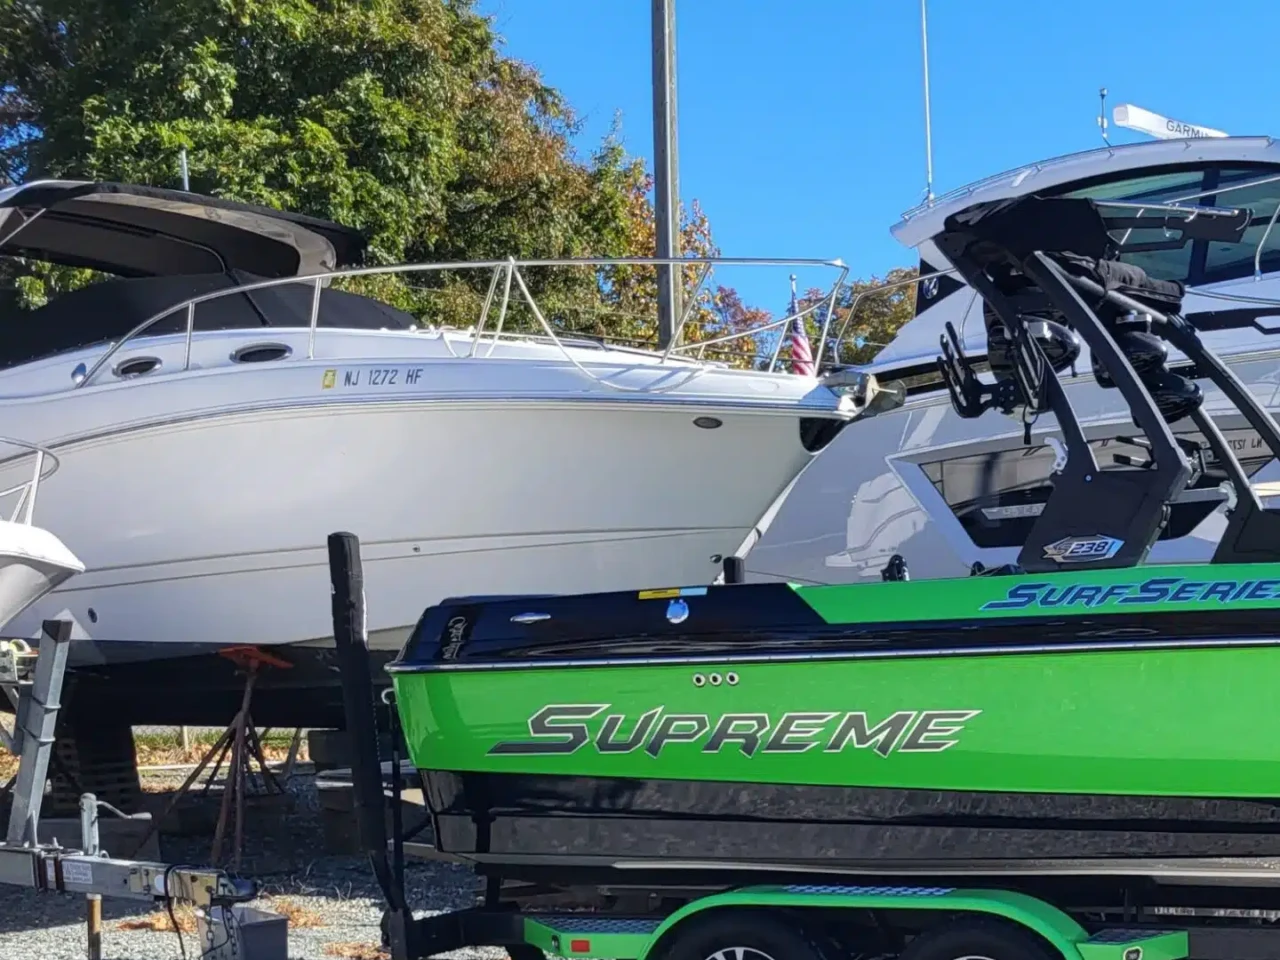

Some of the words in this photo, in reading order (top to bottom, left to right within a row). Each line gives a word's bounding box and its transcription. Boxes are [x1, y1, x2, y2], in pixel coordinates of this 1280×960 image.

[343, 370, 360, 387] NJ
[368, 369, 398, 386] 1272
[405, 368, 423, 385] HF
[485, 704, 983, 759] SUPREME
